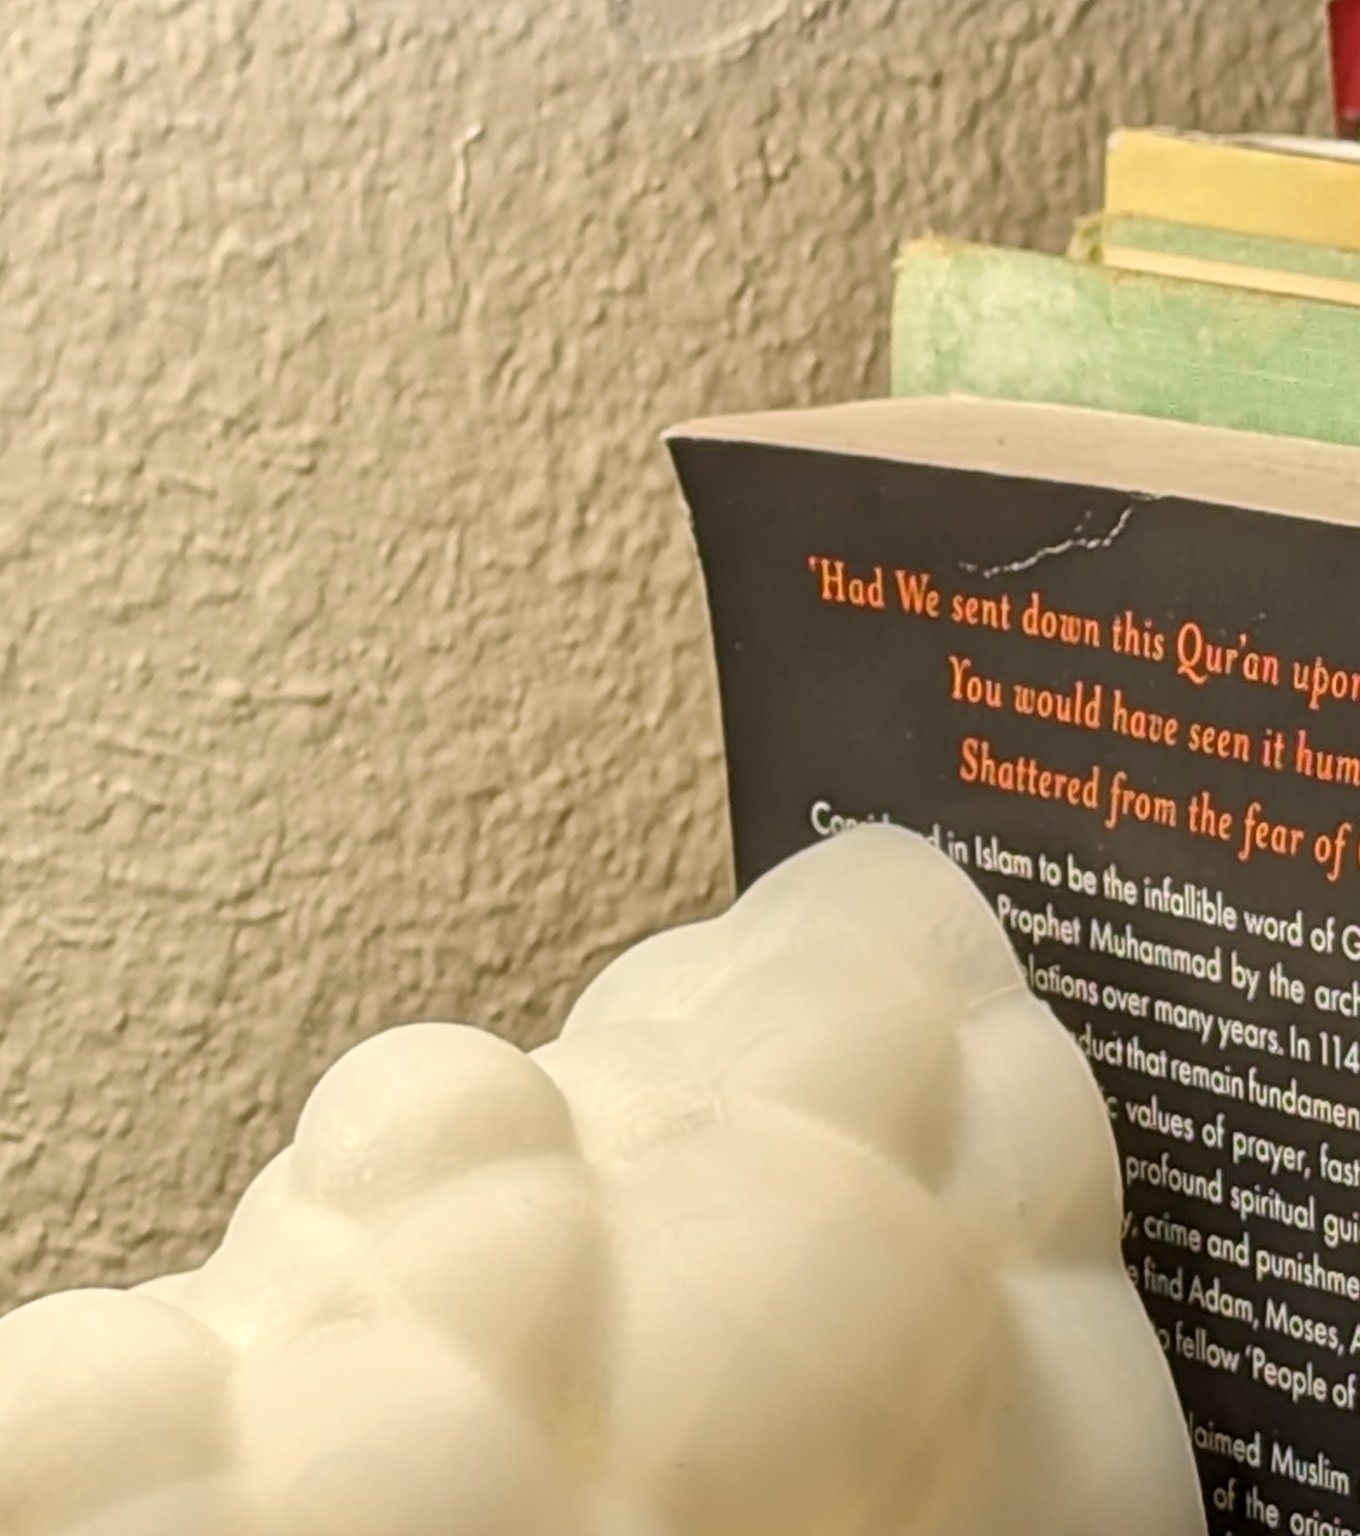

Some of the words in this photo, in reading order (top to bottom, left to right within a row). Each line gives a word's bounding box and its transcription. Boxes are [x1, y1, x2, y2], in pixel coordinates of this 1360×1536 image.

[894, 569, 939, 618] We
[951, 594, 1011, 631] sent
[1021, 592, 1100, 647] down
[1112, 610, 1164, 661] this
[1176, 622, 1279, 686] Qur'an
[949, 655, 1002, 708] You
[1013, 680, 1102, 729] would
[1112, 689, 1178, 746] have
[1187, 723, 1250, 762] seen
[1261, 729, 1285, 770] it
[959, 737, 1100, 809] Shattered
[1104, 770, 1177, 829] from
[1188, 791, 1232, 840] the
[1237, 801, 1304, 861] fear
[1314, 822, 1352, 882] of
[945, 829, 970, 866] in
[972, 835, 1033, 882] Islam
[1038, 853, 1062, 886] to
[1067, 853, 1097, 895] be
[1102, 863, 1138, 905] the
[1143, 876, 1237, 931] infallible
[1243, 909, 1303, 947] word
[1309, 916, 1335, 953] of
[995, 893, 1081, 959] Prophet
[1090, 918, 1222, 983] Muhammad
[1231, 950, 1260, 1001] by
[1268, 961, 1305, 1004] the
[1102, 985, 1150, 1017] over
[1154, 999, 1214, 1043] many
[1217, 1016, 1284, 1056] years.
[1289, 1024, 1311, 1062] In
[1318, 1031, 1360, 1074] 114
[1126, 1036, 1168, 1078] that
[1170, 1058, 1244, 1099] remain
[1125, 1094, 1194, 1142] values
[1201, 1112, 1225, 1148] of
[1232, 1131, 1311, 1179] prayer,
[1125, 1152, 1223, 1204] profound
[1230, 1184, 1315, 1231] spiritual
[1143, 1212, 1202, 1253] crime
[1206, 1231, 1250, 1267] and
[1188, 1275, 1259, 1330] Adam,
[1265, 1298, 1344, 1356] Moses,
[1175, 1320, 1240, 1373] fellow
[1245, 1345, 1327, 1402] 'People
[1332, 1373, 1356, 1409] of
[1213, 1477, 1236, 1511] of
[1245, 1486, 1280, 1529] the
[1271, 1442, 1350, 1495] Muslim
